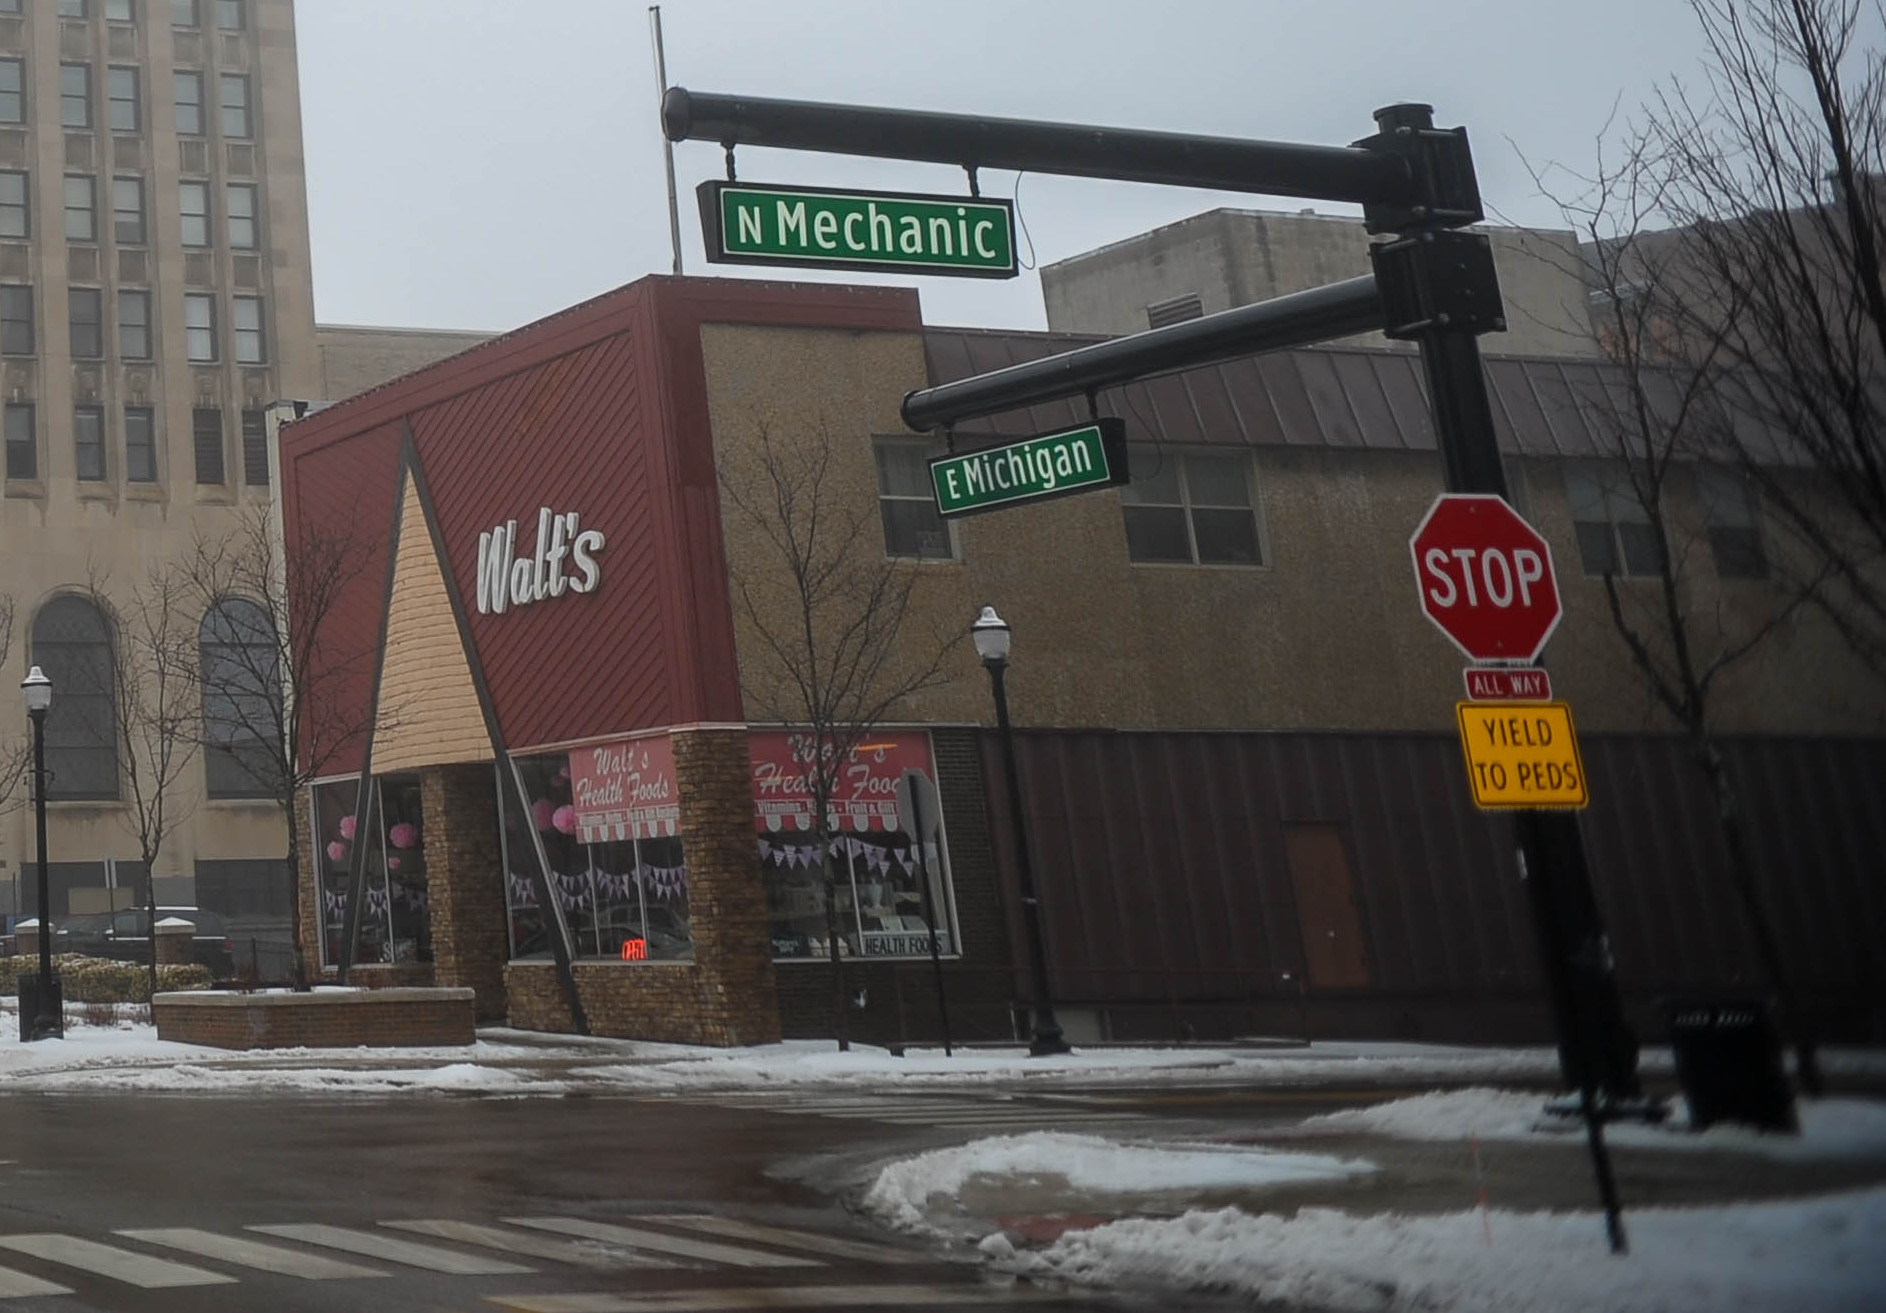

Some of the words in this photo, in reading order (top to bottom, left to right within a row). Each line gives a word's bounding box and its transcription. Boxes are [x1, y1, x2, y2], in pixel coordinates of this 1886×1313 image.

[737, 204, 763, 245] N
[776, 200, 997, 259] Mechanic
[945, 468, 961, 500] E
[962, 438, 1093, 496] Michigan
[476, 506, 606, 615] Walt's
[1424, 547, 1544, 609] STOP
[1473, 675, 1504, 696] ALL
[1509, 675, 1543, 696] WAY
[1481, 717, 1554, 748] YIELD
[593, 741, 651, 775] Walt's
[576, 774, 624, 807] Health
[628, 772, 670, 808] Foods
[1475, 761, 1508, 791] TO
[1517, 761, 1579, 792] PEDS
[865, 937, 905, 954] HEALTH
[909, 936, 943, 953] FOOS
